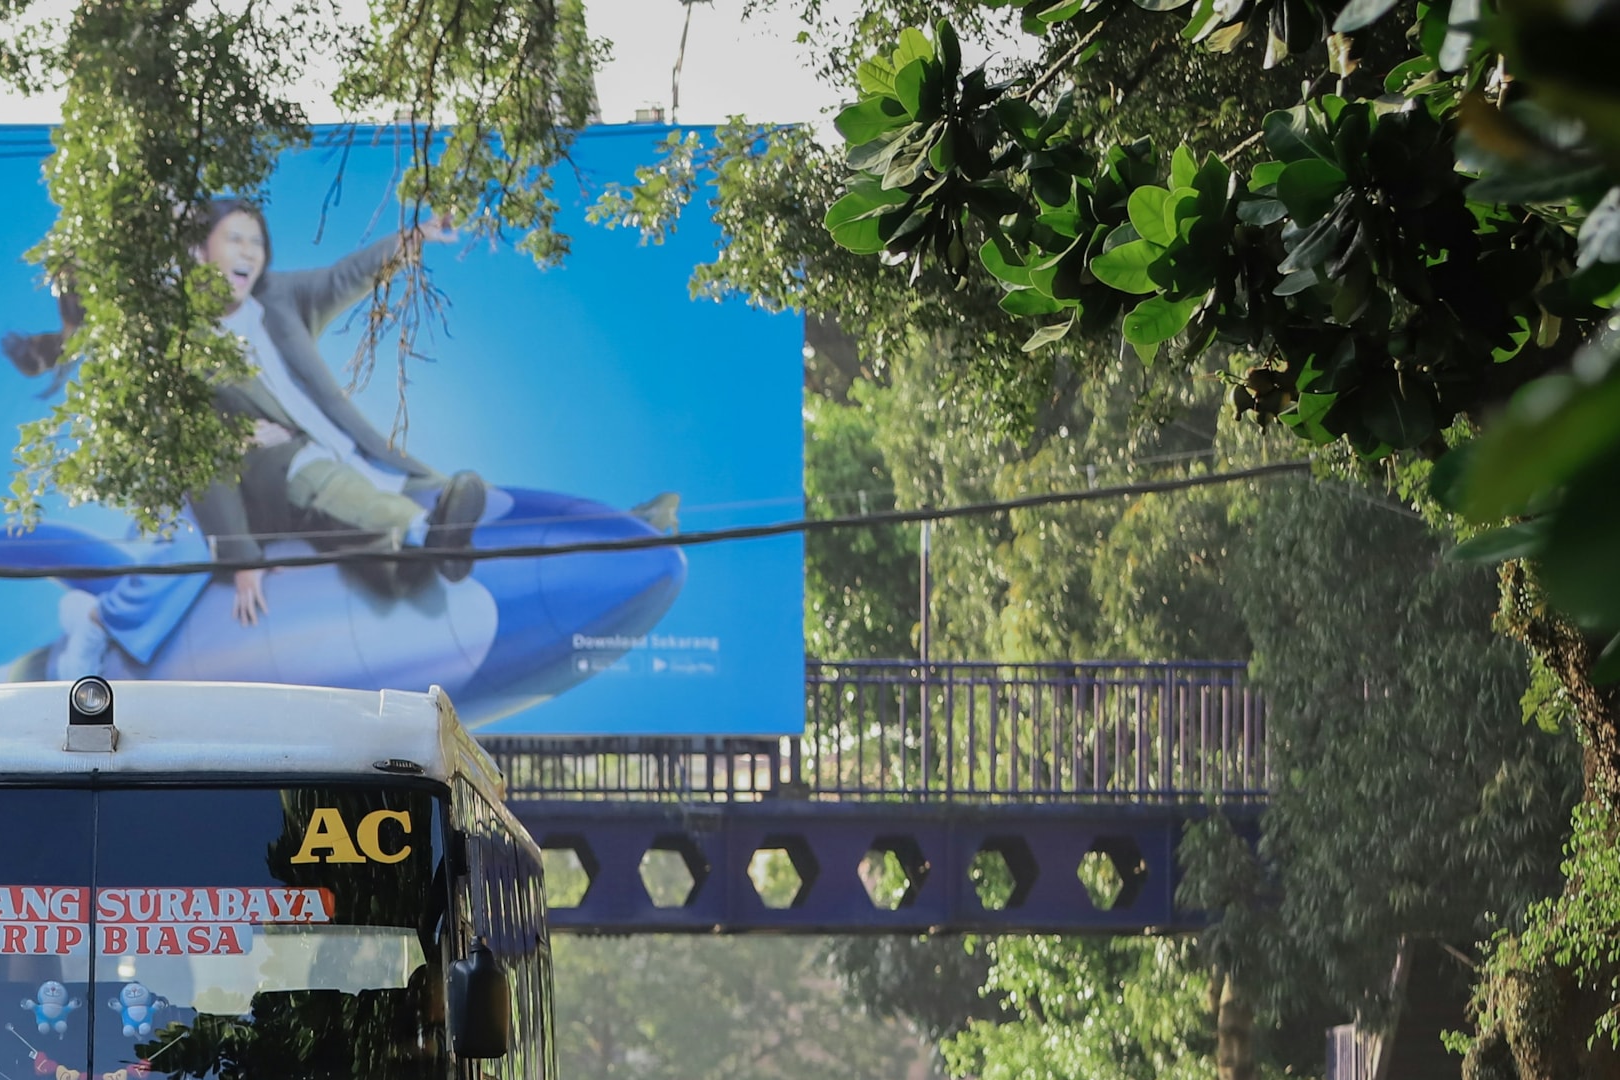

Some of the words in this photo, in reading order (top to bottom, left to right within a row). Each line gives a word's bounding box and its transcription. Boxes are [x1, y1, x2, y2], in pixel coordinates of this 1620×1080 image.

[572, 634, 647, 649] Download
[651, 635, 719, 651] Sekarang
[290, 807, 412, 865] AC
[96, 887, 330, 923] SURABAYA
[101, 923, 244, 955] BIASA
